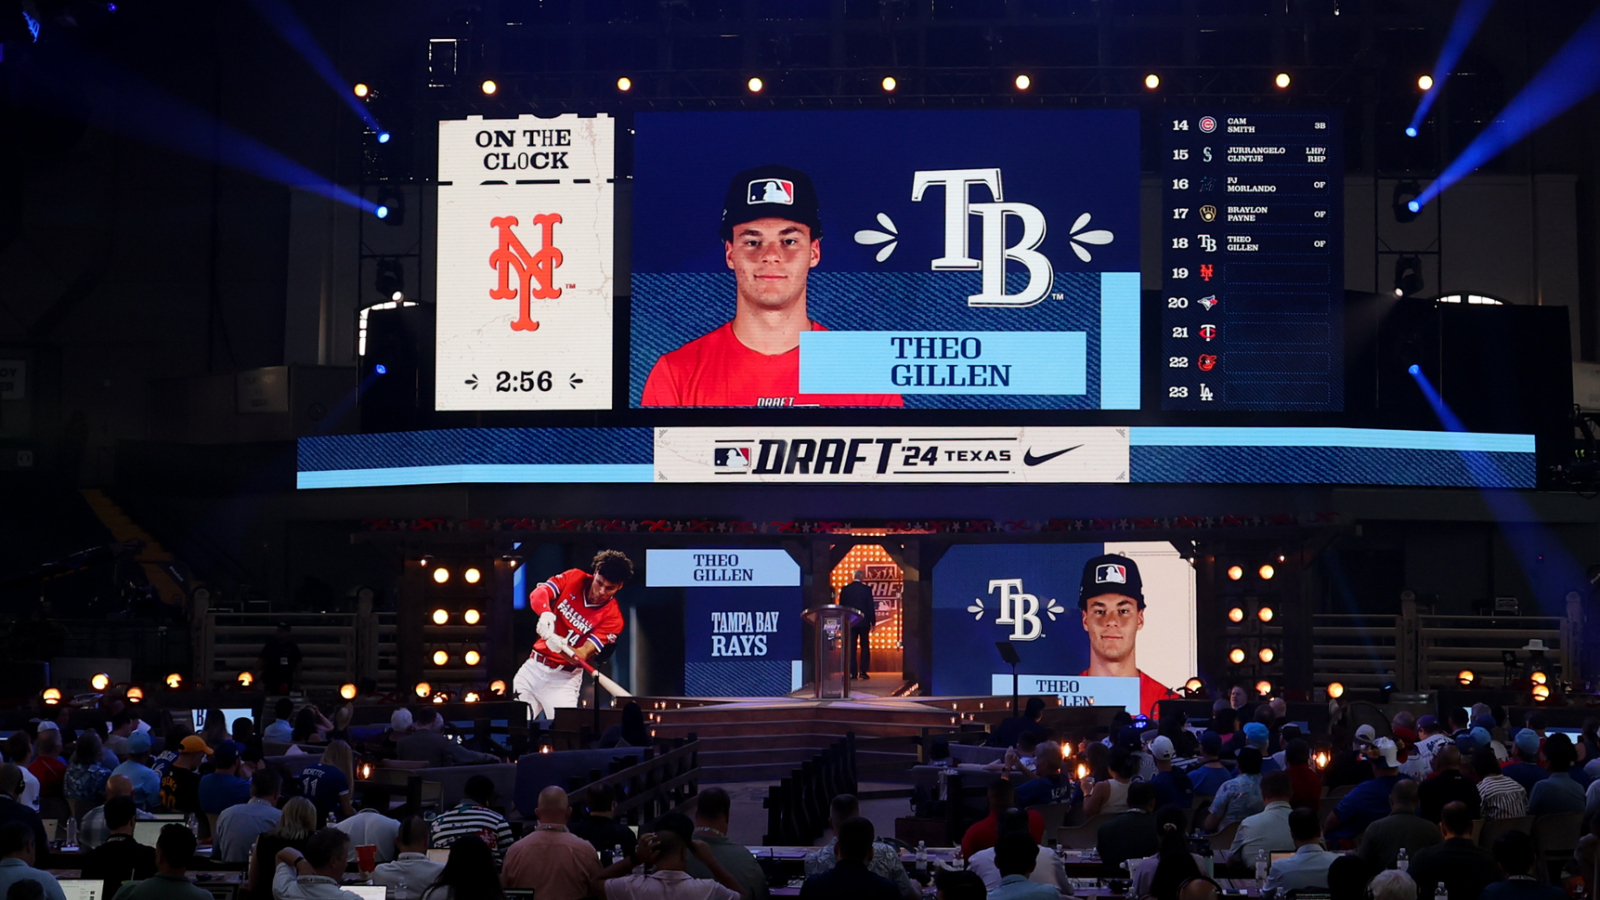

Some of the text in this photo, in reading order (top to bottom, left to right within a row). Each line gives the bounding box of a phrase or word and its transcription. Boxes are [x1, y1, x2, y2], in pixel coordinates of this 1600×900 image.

[1173, 120, 1189, 131] 14
[475, 129, 571, 147] ON THE
[1173, 149, 1189, 160] 15
[1305, 147, 1326, 155] LHP/
[483, 151, 569, 170] CLOCK
[1307, 155, 1326, 163] RHP
[1172, 179, 1189, 190] 16
[1173, 208, 1189, 219] 17
[1227, 206, 1268, 214] BRAYLON
[911, 168, 1055, 308] TB
[1172, 238, 1189, 249] 18
[1172, 268, 1189, 279] 19
[1168, 297, 1189, 308] 20
[1172, 327, 1189, 338] 21
[890, 337, 982, 360] THEO
[1169, 357, 1189, 368] 22
[496, 371, 553, 392] 2:56
[890, 365, 1012, 387] GILLEN
[1169, 386, 1189, 398] 23
[757, 397, 795, 406] DRAFT
[751, 437, 902, 474] DRAFT
[944, 450, 1011, 461] TEXAS
[693, 553, 739, 567] THEO
[693, 568, 754, 582] GILLEN
[988, 578, 1042, 641] TB
[557, 602, 591, 634] FACTORY
[711, 611, 779, 633] TAMPA BAY
[565, 629, 581, 647] 14
[711, 635, 768, 657] RAYS
[1036, 680, 1080, 693] THEO
